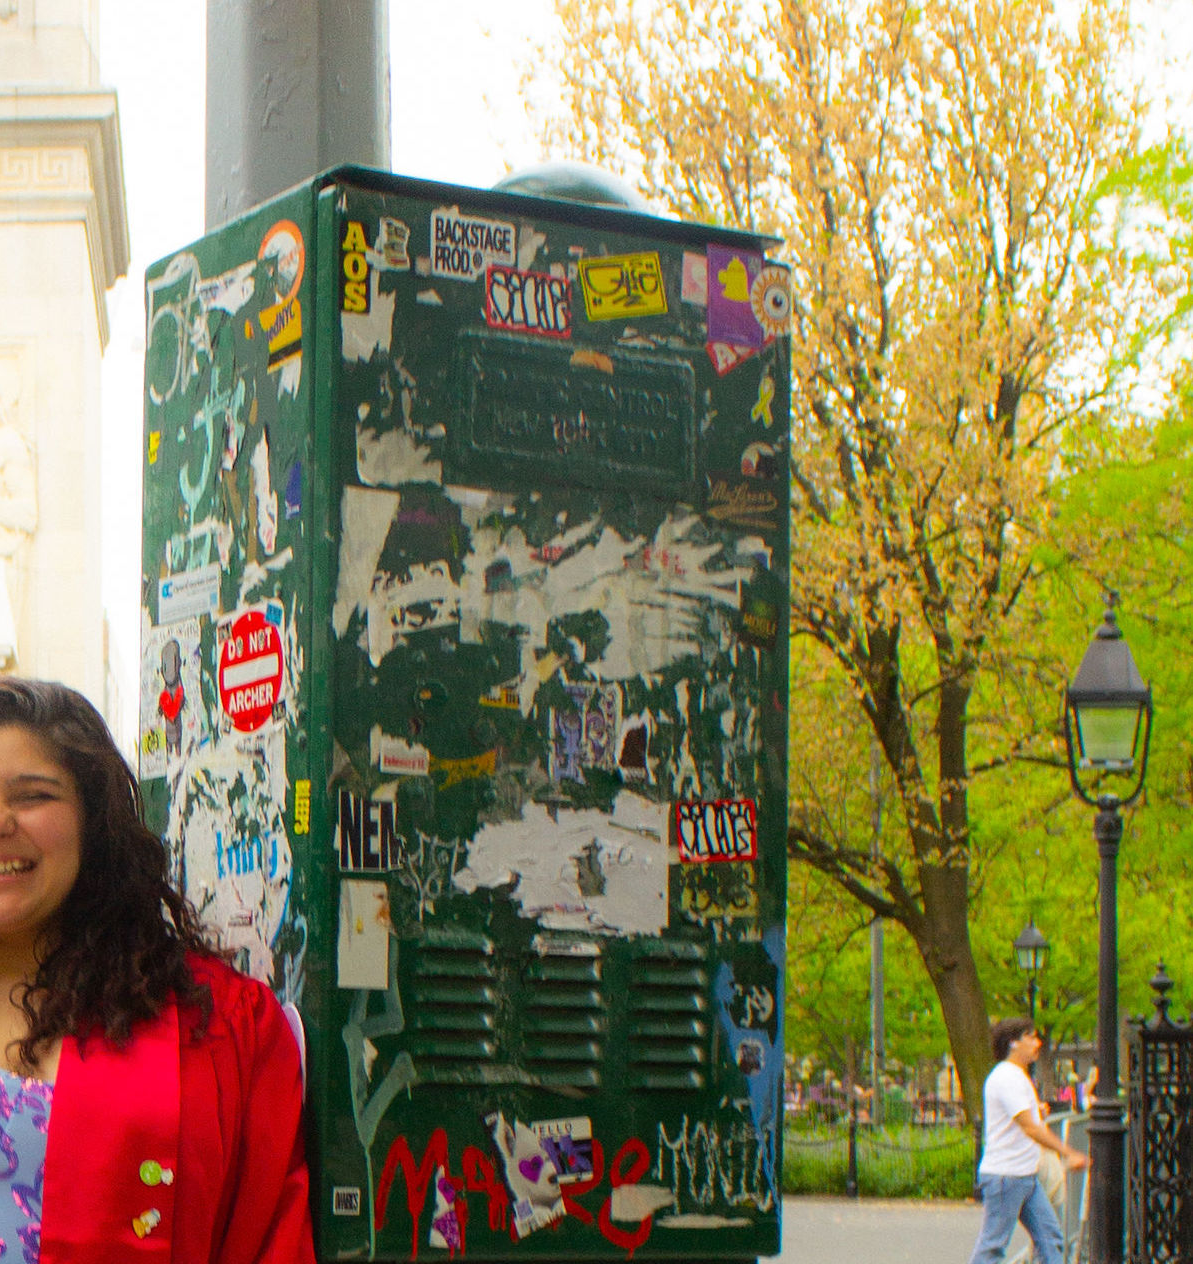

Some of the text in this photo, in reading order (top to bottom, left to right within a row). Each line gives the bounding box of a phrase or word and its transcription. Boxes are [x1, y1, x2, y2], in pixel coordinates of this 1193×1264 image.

[434, 214, 512, 254] BACKSTAGE
[342, 220, 368, 314] AOS
[227, 625, 273, 661] DO NOT
[228, 682, 274, 714] ARCHER
